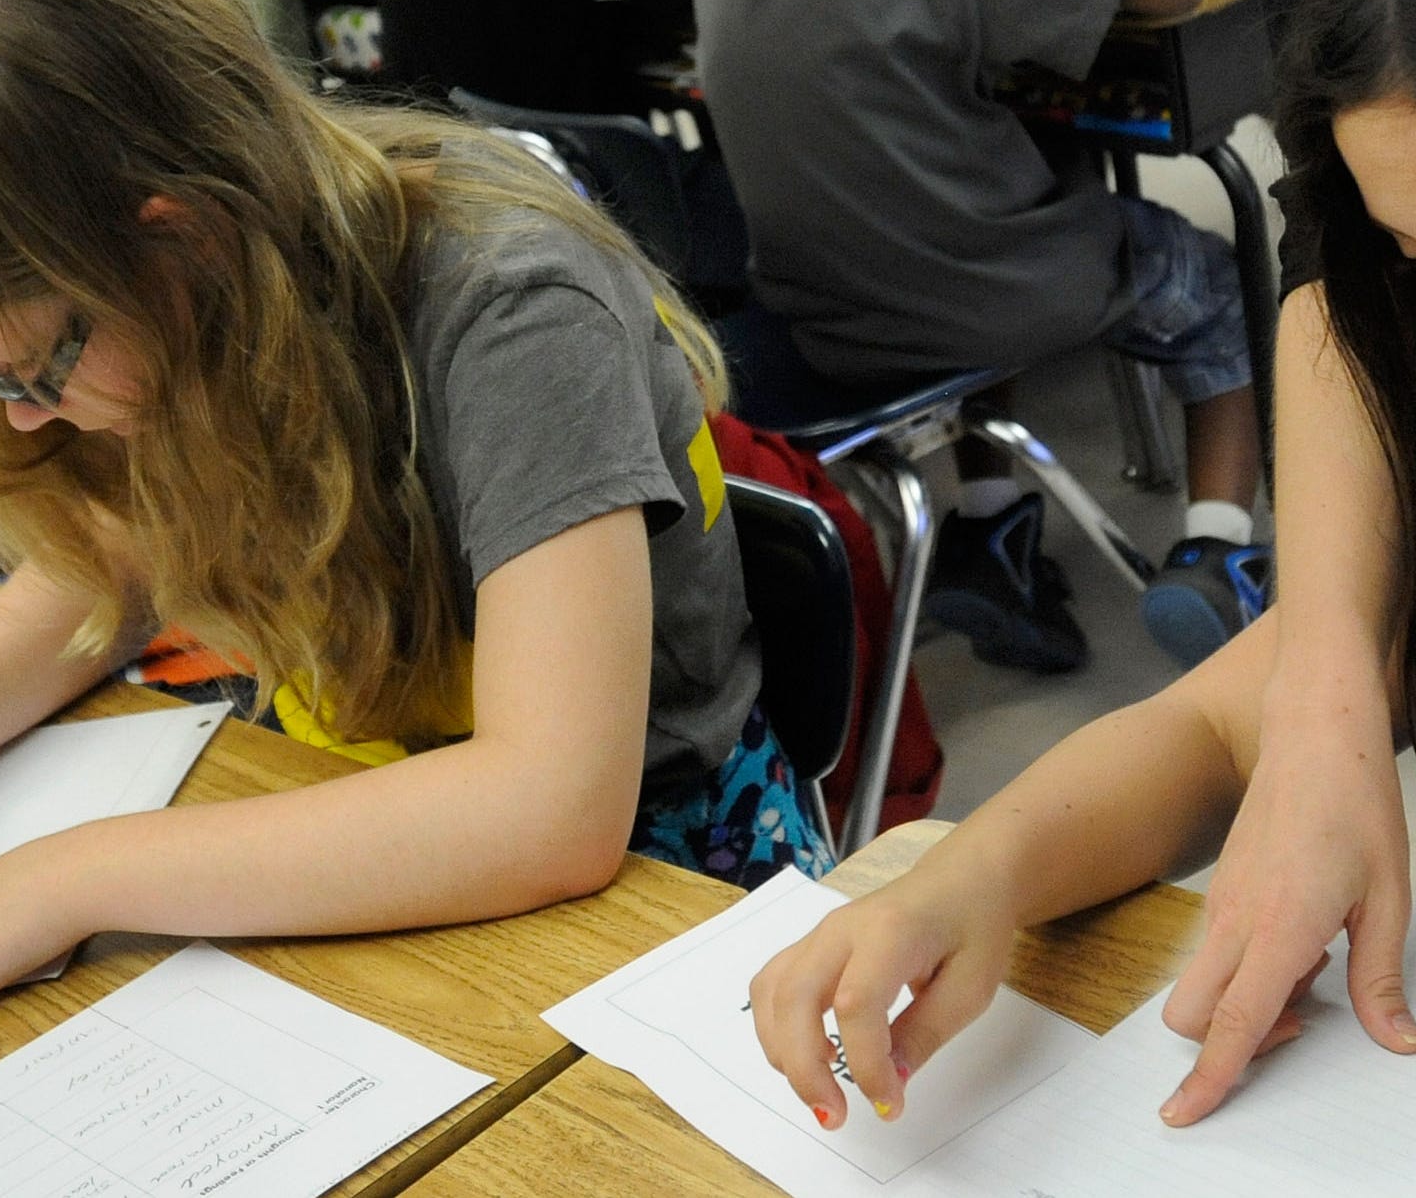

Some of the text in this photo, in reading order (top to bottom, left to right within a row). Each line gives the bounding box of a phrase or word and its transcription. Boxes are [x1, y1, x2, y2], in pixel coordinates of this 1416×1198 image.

[324, 1081, 377, 1115] Character
[166, 1095, 225, 1137] mad
[180, 1123, 280, 1190] Annoyed
[256, 1128, 306, 1160] Thoughts
[199, 1165, 245, 1196] Feelings
